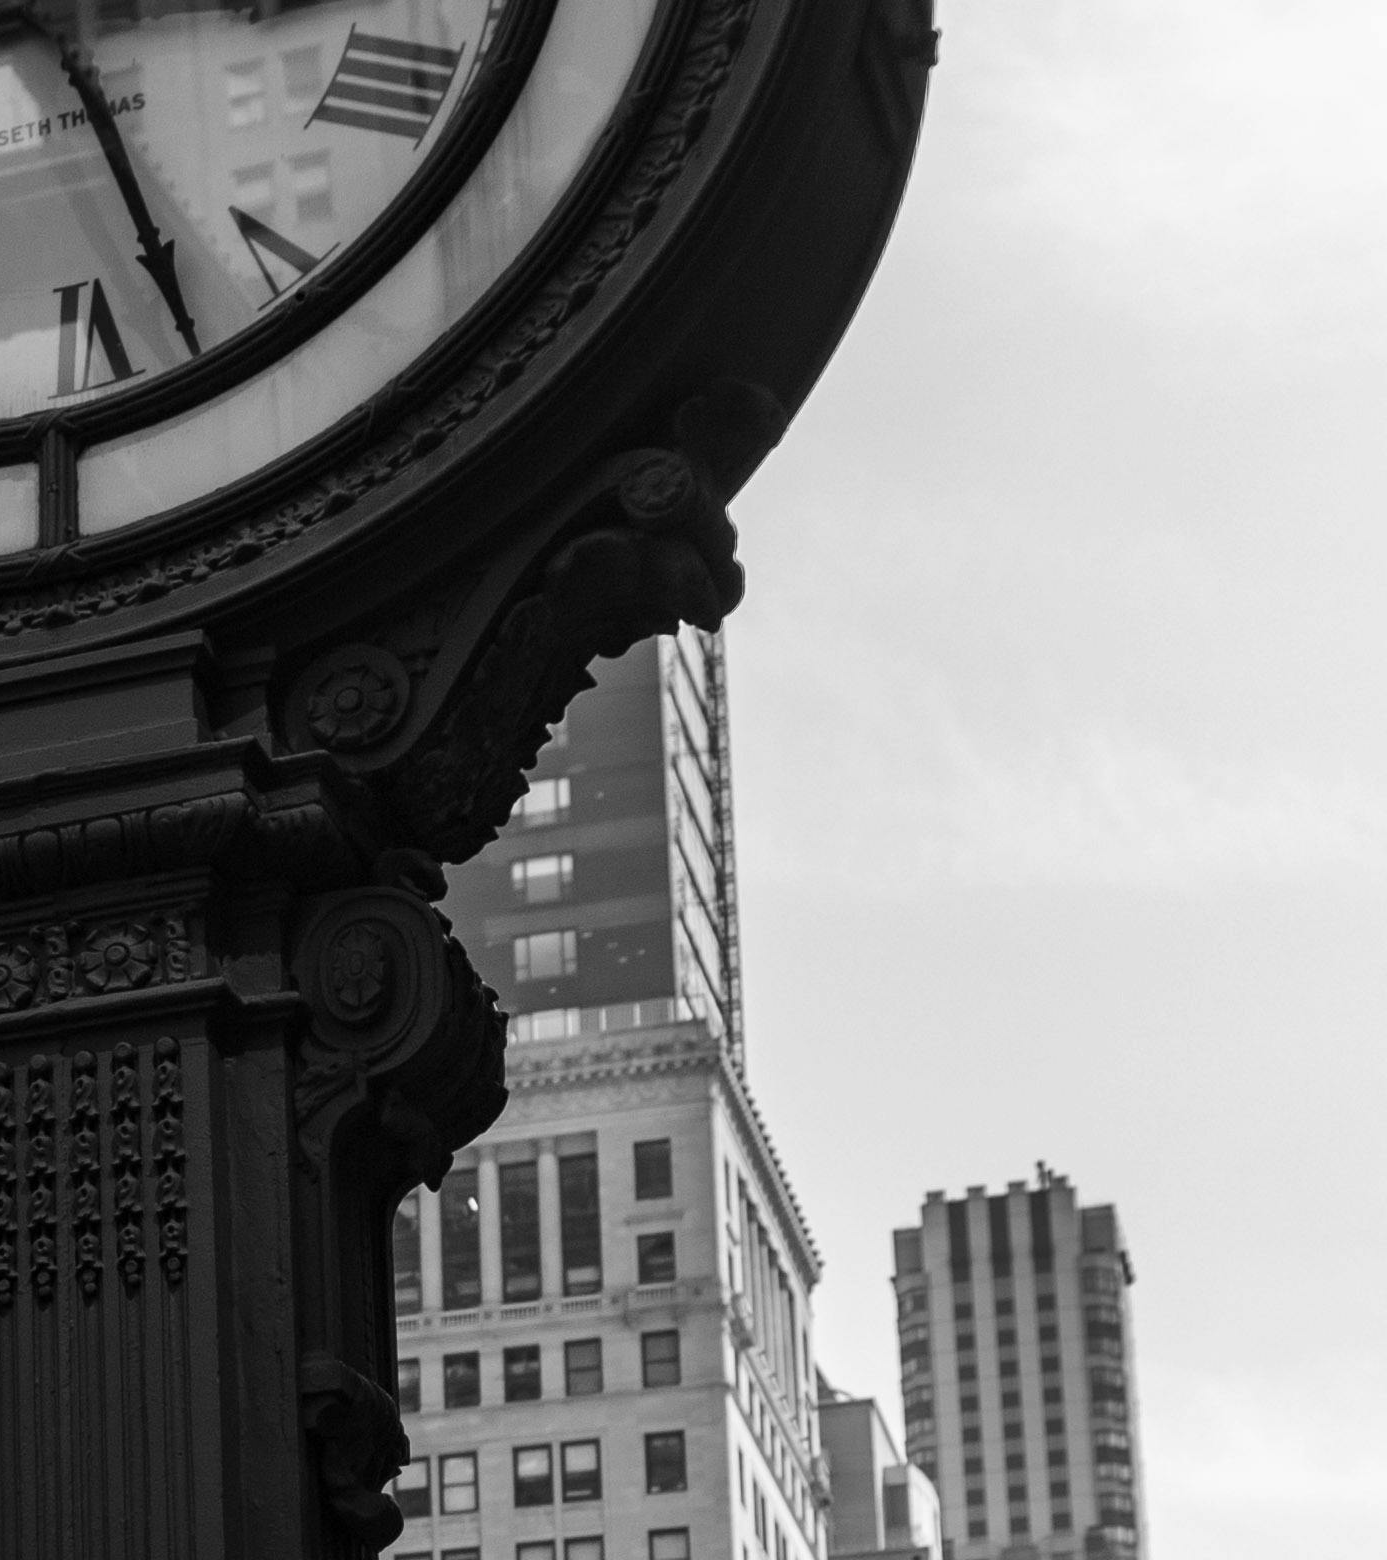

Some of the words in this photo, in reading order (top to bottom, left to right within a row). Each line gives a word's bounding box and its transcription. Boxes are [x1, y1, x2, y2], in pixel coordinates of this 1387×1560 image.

[58, 92, 146, 131] THAS
[305, 23, 464, 148] IIII
[228, 205, 341, 312] V
[49, 277, 148, 400] VI
